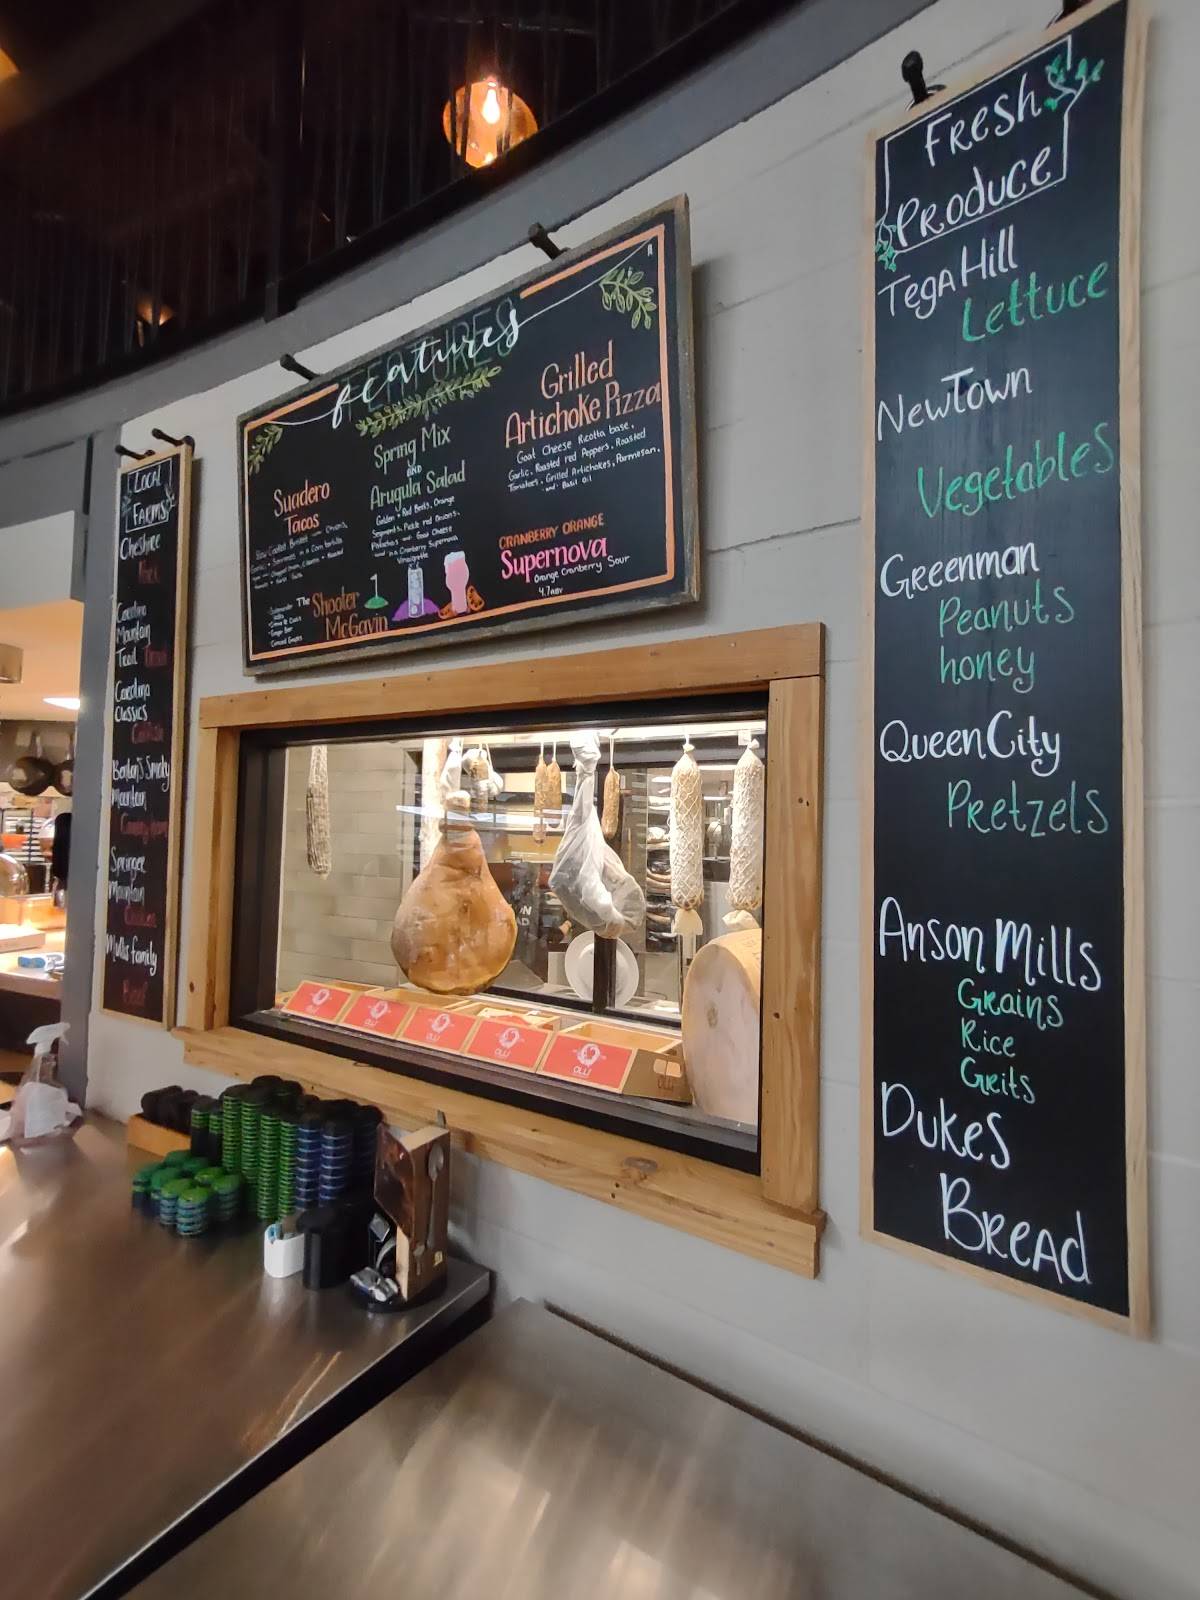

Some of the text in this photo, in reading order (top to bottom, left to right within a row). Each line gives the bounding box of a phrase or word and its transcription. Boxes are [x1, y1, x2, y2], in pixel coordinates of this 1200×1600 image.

[962, 262, 1108, 342] Lettuce
[541, 339, 614, 400] Grilled
[605, 381, 662, 420] Pizza
[421, 423, 451, 452] Mix
[517, 448, 536, 464] Goat
[542, 440, 572, 456] Cheese
[578, 430, 606, 444] Ricotta
[564, 453, 577, 464] red
[616, 427, 646, 447] Roasted
[370, 460, 465, 512] Arugula Salad
[545, 470, 569, 483] Grilled
[273, 479, 330, 517] Suadero
[284, 513, 320, 536] Tacos
[499, 513, 604, 549] CRANBERRY ORANGE
[501, 537, 608, 584] Supernova
[534, 555, 630, 583] Orange Cranberry Sour
[312, 585, 361, 618] Shooter
[940, 578, 1075, 637] Peanuts
[326, 613, 389, 641] McGavin
[940, 645, 1034, 693] honey
[879, 896, 1102, 992] Anson Mills
[961, 1017, 1016, 1057] Rice
